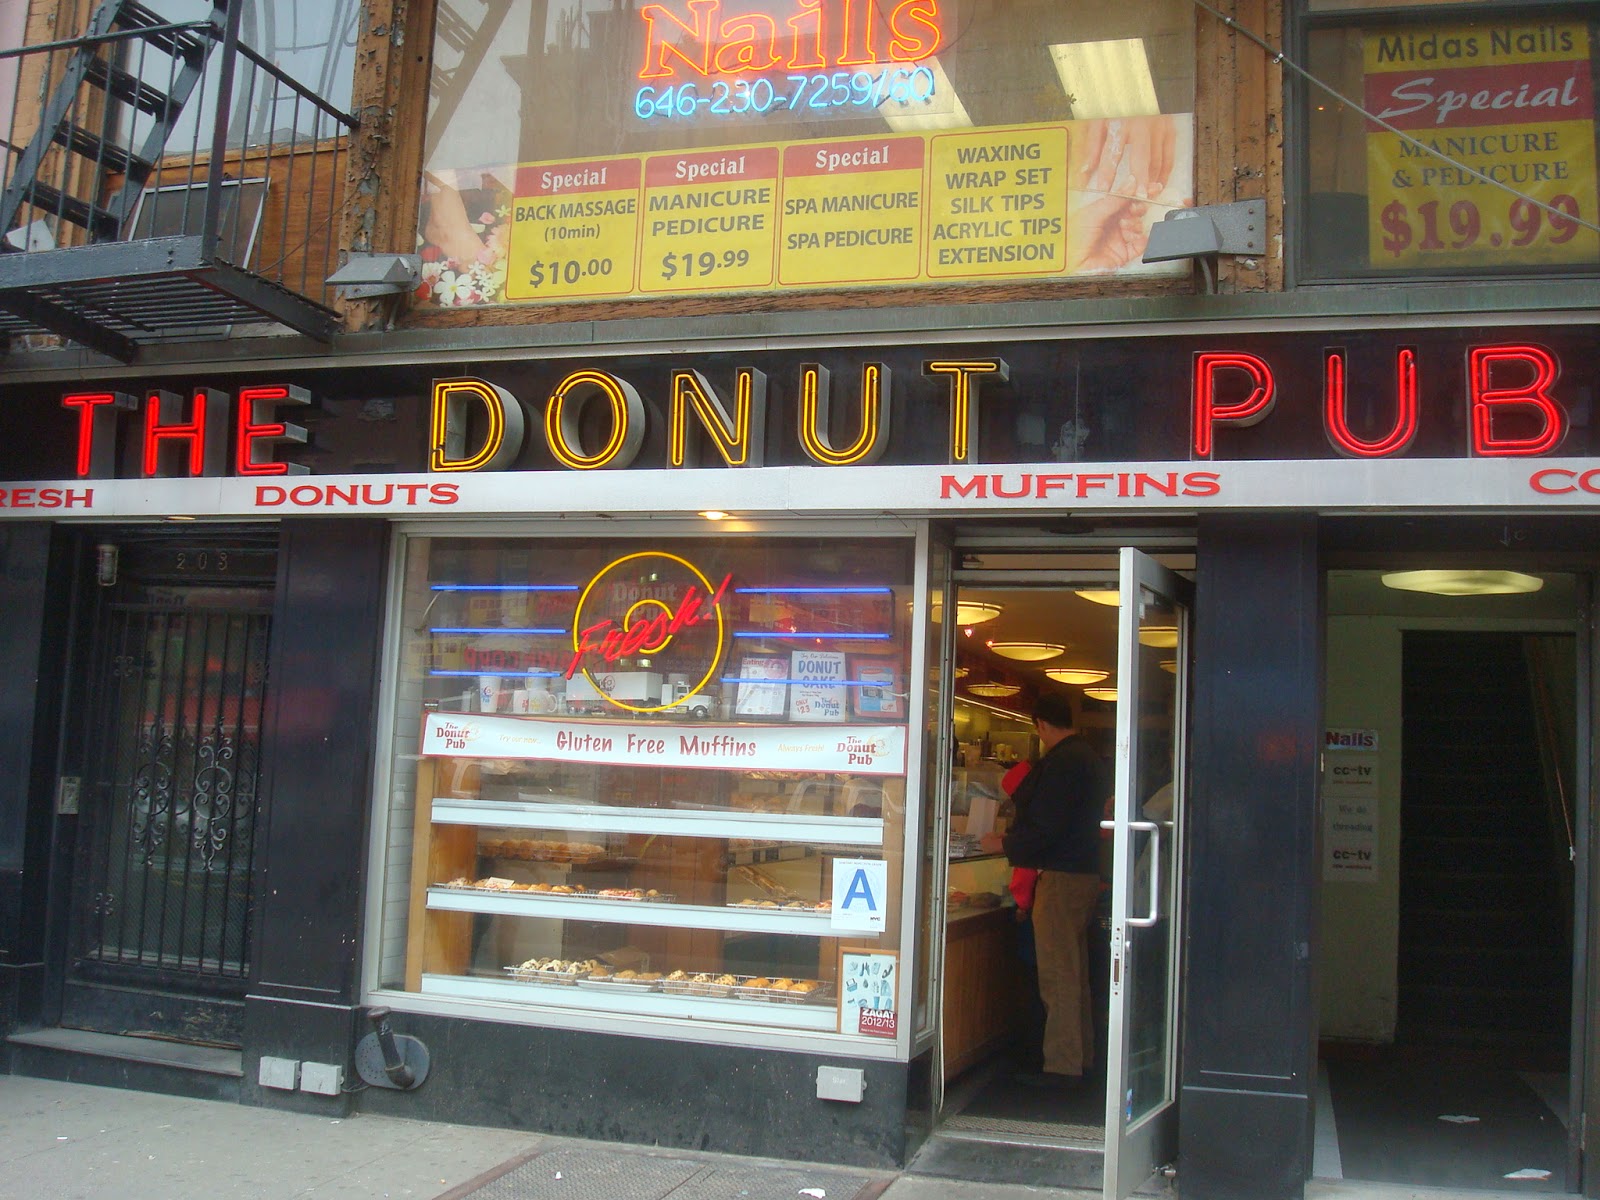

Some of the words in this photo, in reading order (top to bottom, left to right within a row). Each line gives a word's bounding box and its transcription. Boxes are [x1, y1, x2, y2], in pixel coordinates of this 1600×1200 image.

[638, 0, 942, 79] Nails
[1377, 34, 1479, 63] Midas
[1490, 25, 1573, 56] Nails
[1377, 77, 1579, 124] Special
[957, 143, 1041, 164] WAXING
[1400, 132, 1559, 158] MANICURE
[676, 156, 745, 181] Special
[815, 145, 889, 171] Special
[541, 167, 607, 192] Special
[945, 170, 1006, 189] WRAP
[1015, 168, 1052, 186] SET
[1392, 169, 1411, 188] &
[1422, 161, 1569, 187] PEDICURE
[515, 204, 555, 222] BACK
[559, 198, 636, 218] MASSAGE
[649, 188, 771, 212] MANICURE
[785, 197, 818, 215] SPA
[821, 192, 919, 213] MANICURE
[950, 196, 994, 215] SILK
[1001, 193, 1045, 211] TIPS
[544, 224, 601, 242] (10min)
[652, 214, 765, 236] PEDICURE
[933, 220, 1013, 241] ACRYLIC
[1020, 217, 1062, 235] TIPS
[1380, 193, 1580, 257] $19.99
[787, 232, 820, 250] SPA
[825, 227, 913, 247] PEDICURE
[661, 250, 750, 281] $19.99
[938, 243, 1055, 265] EXTENSION
[529, 258, 613, 288] $10.00
[61, 384, 311, 477] THE
[430, 360, 1008, 472] DONUT
[1190, 343, 1569, 459] PUB
[255, 483, 460, 508] DONUTS
[939, 472, 1222, 500] MUFFINS
[176, 552, 229, 571] 203
[565, 573, 733, 680] Fresh!
[798, 660, 842, 674] DONUT
[814, 700, 840, 709] Donut
[824, 709, 840, 717] Pub
[436, 727, 470, 738] Donut
[445, 739, 466, 749] Pub
[556, 730, 612, 752] Gluten
[627, 733, 665, 754] Free
[679, 735, 756, 757] Muffins
[847, 736, 862, 744] The
[1325, 731, 1374, 747] Nails
[778, 744, 802, 753] Always
[836, 743, 877, 754] Donut
[848, 753, 873, 765] Pub
[841, 868, 877, 911] A
[861, 1016, 895, 1029] 2012/13
[862, 1008, 895, 1020] ZAGAT
